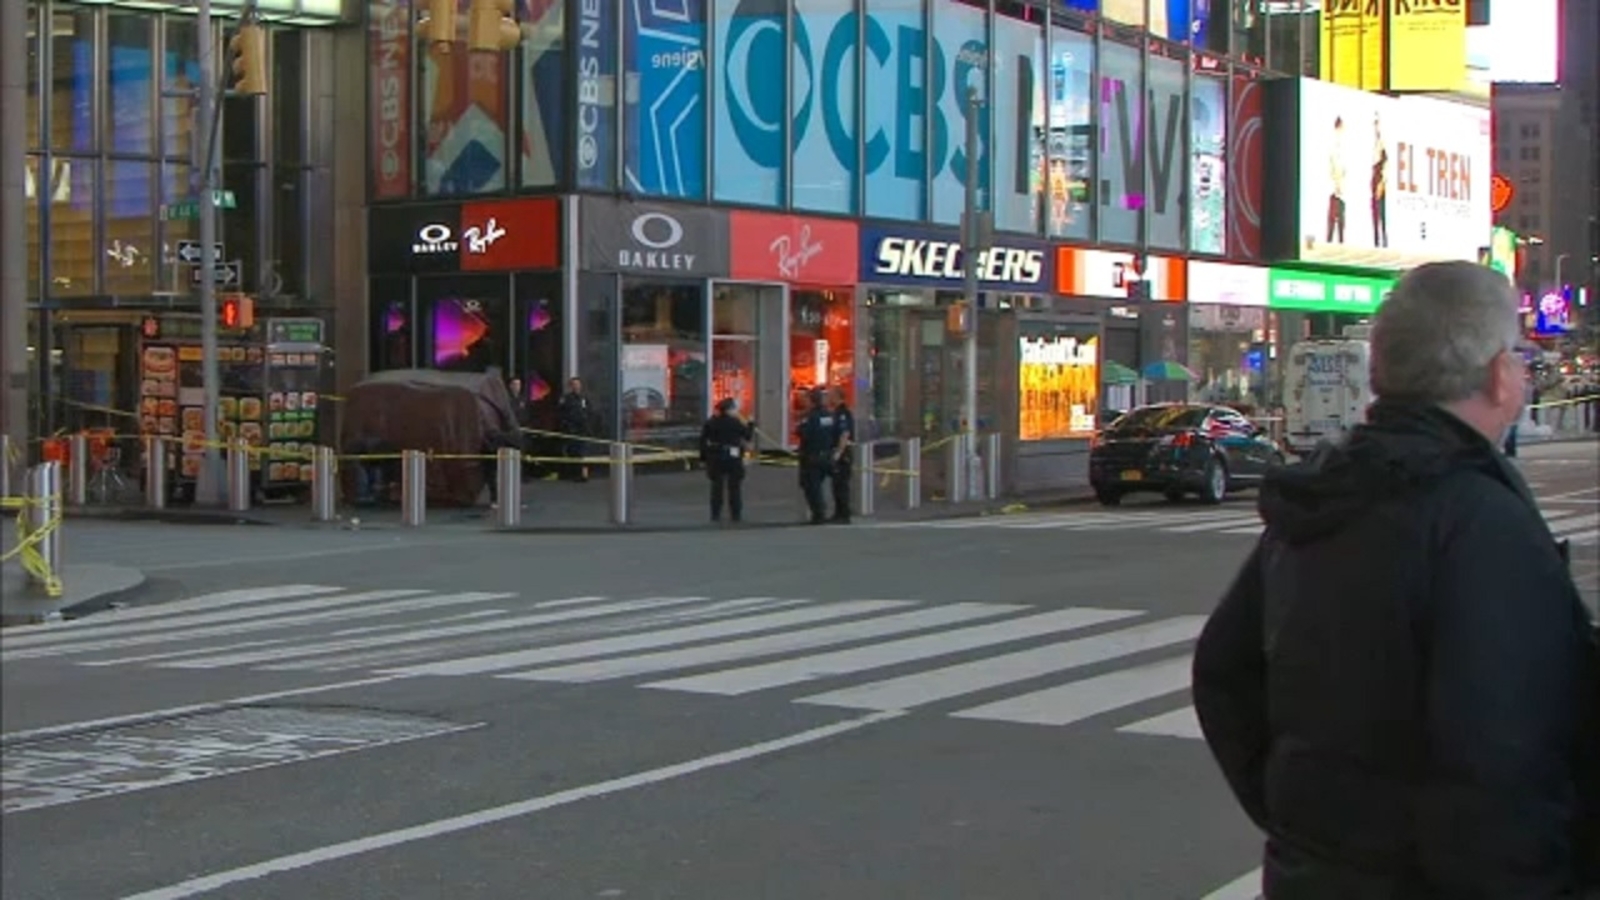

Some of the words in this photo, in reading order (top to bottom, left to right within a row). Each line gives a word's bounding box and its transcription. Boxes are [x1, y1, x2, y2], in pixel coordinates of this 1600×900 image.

[579, 56, 599, 133] CBS
[821, 11, 991, 192] CBS
[1397, 142, 1418, 193] EL
[1426, 147, 1471, 202] TREN
[619, 250, 696, 270] OAKLEY
